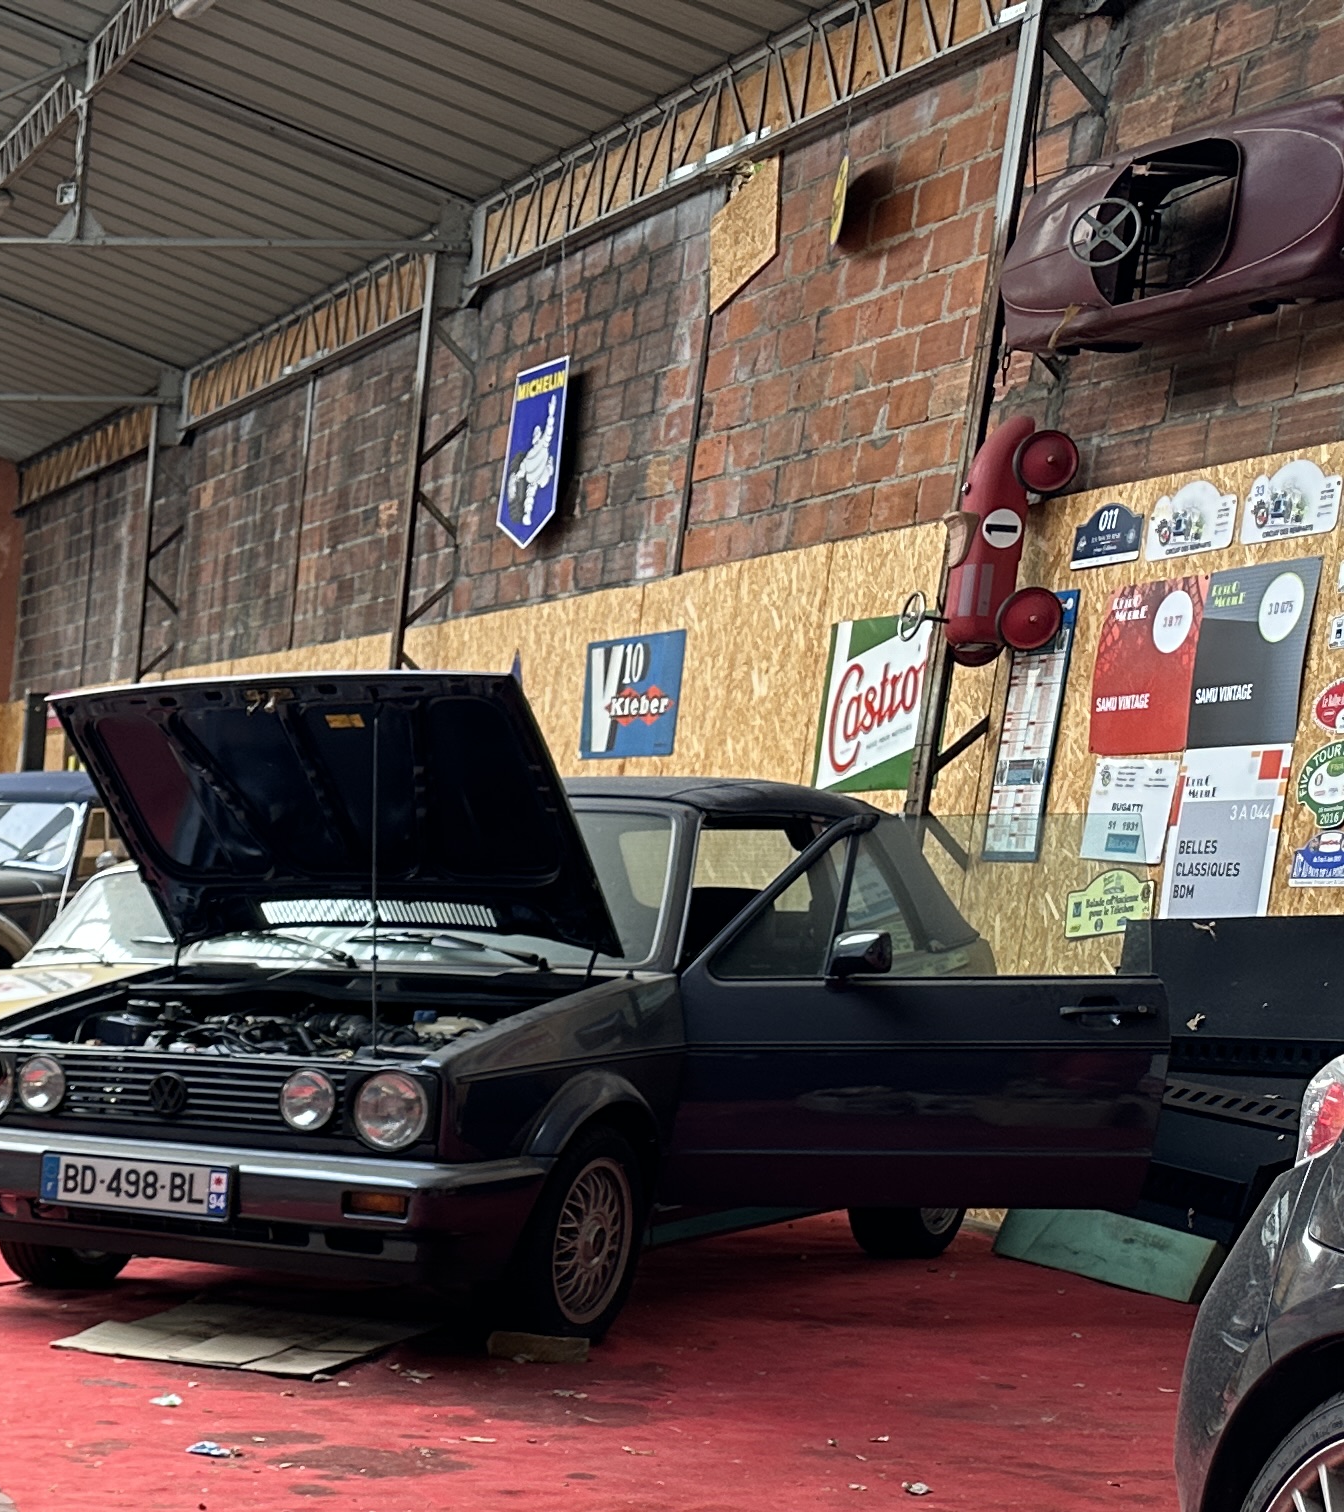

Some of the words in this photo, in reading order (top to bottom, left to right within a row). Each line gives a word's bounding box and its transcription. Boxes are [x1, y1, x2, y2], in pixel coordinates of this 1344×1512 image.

[516, 370, 566, 401] MICHELIN
[1098, 507, 1119, 531] 011
[1096, 695, 1118, 712] SAMU
[1118, 693, 1150, 710] VINTAGE
[1195, 687, 1218, 704] SAMU
[1219, 684, 1253, 702] VINTAGE
[829, 660, 927, 775] Castro
[1299, 765, 1313, 798] FIVA
[1313, 743, 1342, 767] TOUR
[1111, 803, 1143, 812] BUGATTI
[1229, 804, 1237, 820] 3
[1238, 804, 1247, 820] A
[1250, 803, 1271, 820] 044
[1319, 811, 1339, 825] 2016
[1178, 840, 1218, 855] BELLES
[1175, 861, 1240, 877] CLASSIQUES
[63, 1163, 204, 1205] BD-498-BL
[208, 1193, 226, 1210] 94
